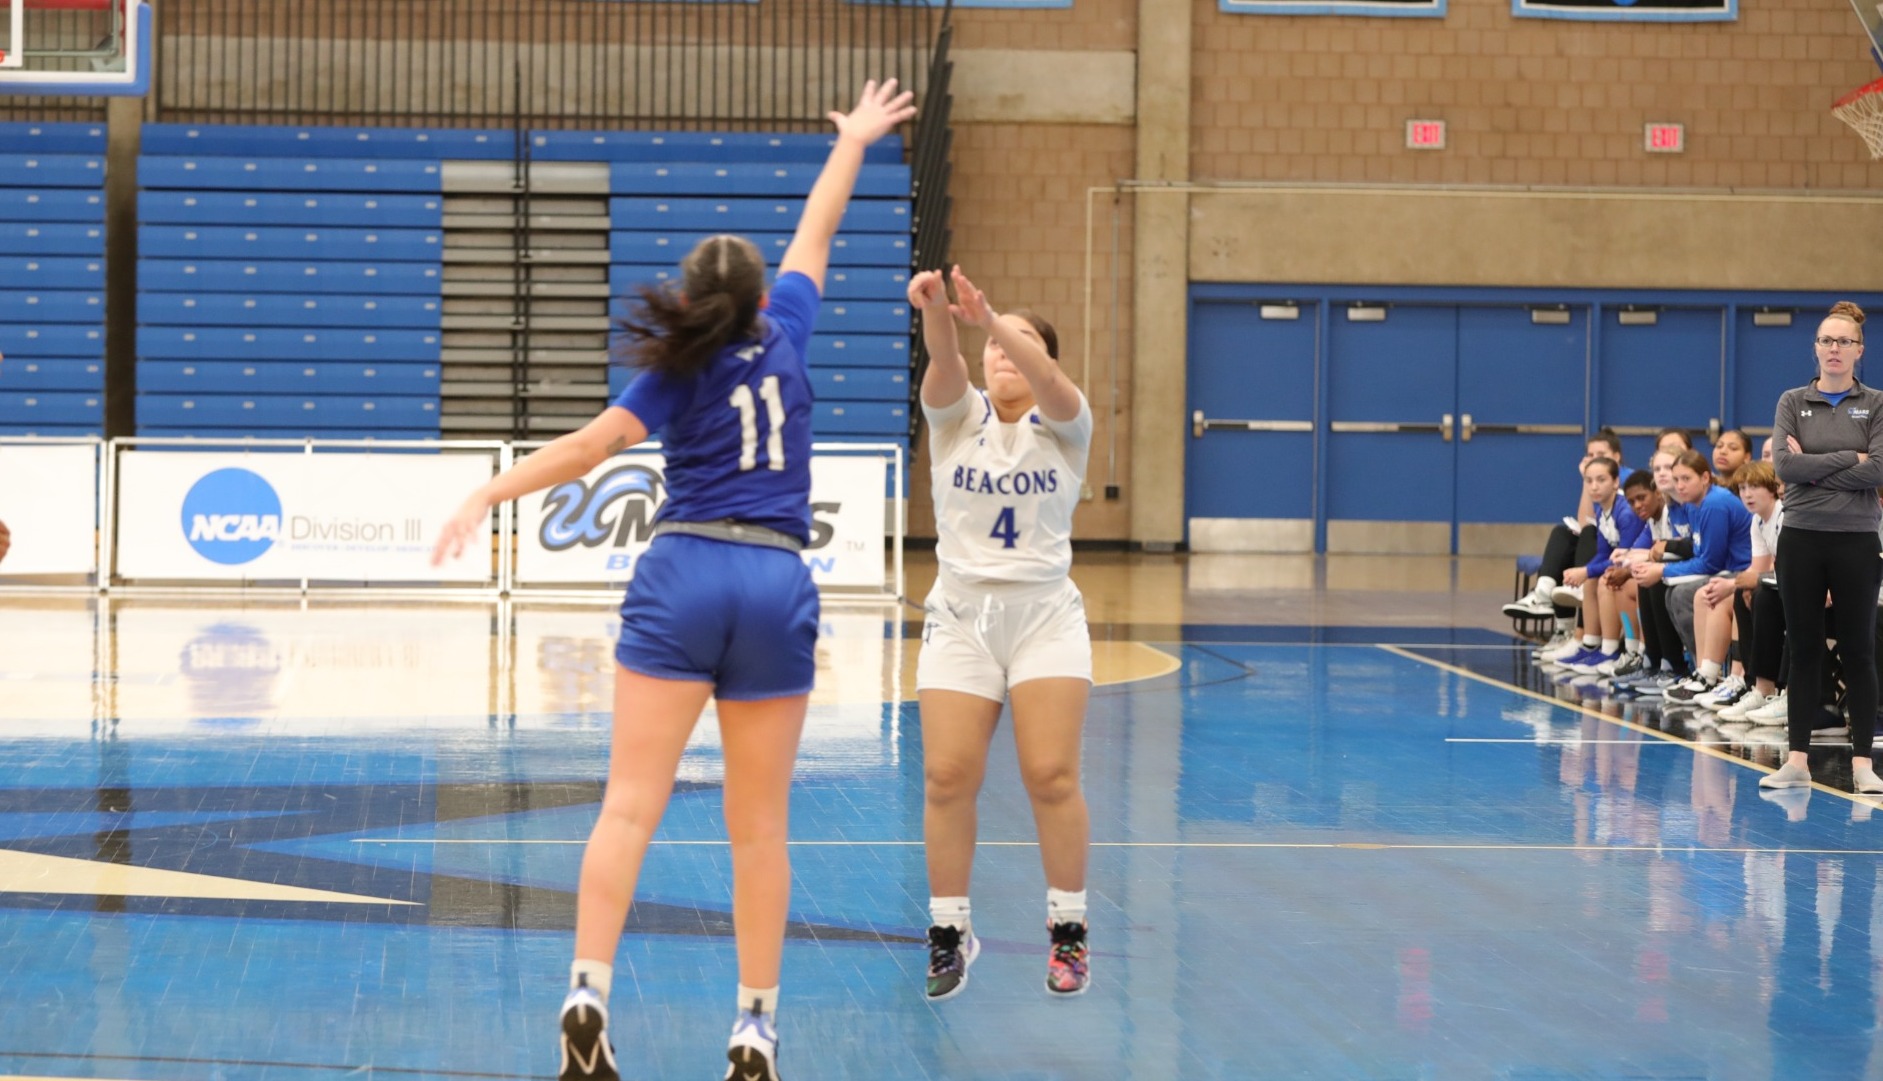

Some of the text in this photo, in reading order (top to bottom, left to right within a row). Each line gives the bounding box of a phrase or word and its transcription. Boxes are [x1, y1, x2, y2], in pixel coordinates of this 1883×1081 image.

[1412, 123, 1440, 145] EXIT
[1651, 126, 1679, 148] EXIT
[729, 374, 787, 472] 11
[953, 464, 1058, 496] BEACONS
[189, 514, 283, 543] NCAA
[291, 515, 395, 542] Division
[988, 506, 1021, 550] 4
[846, 540, 866, 551] TM
